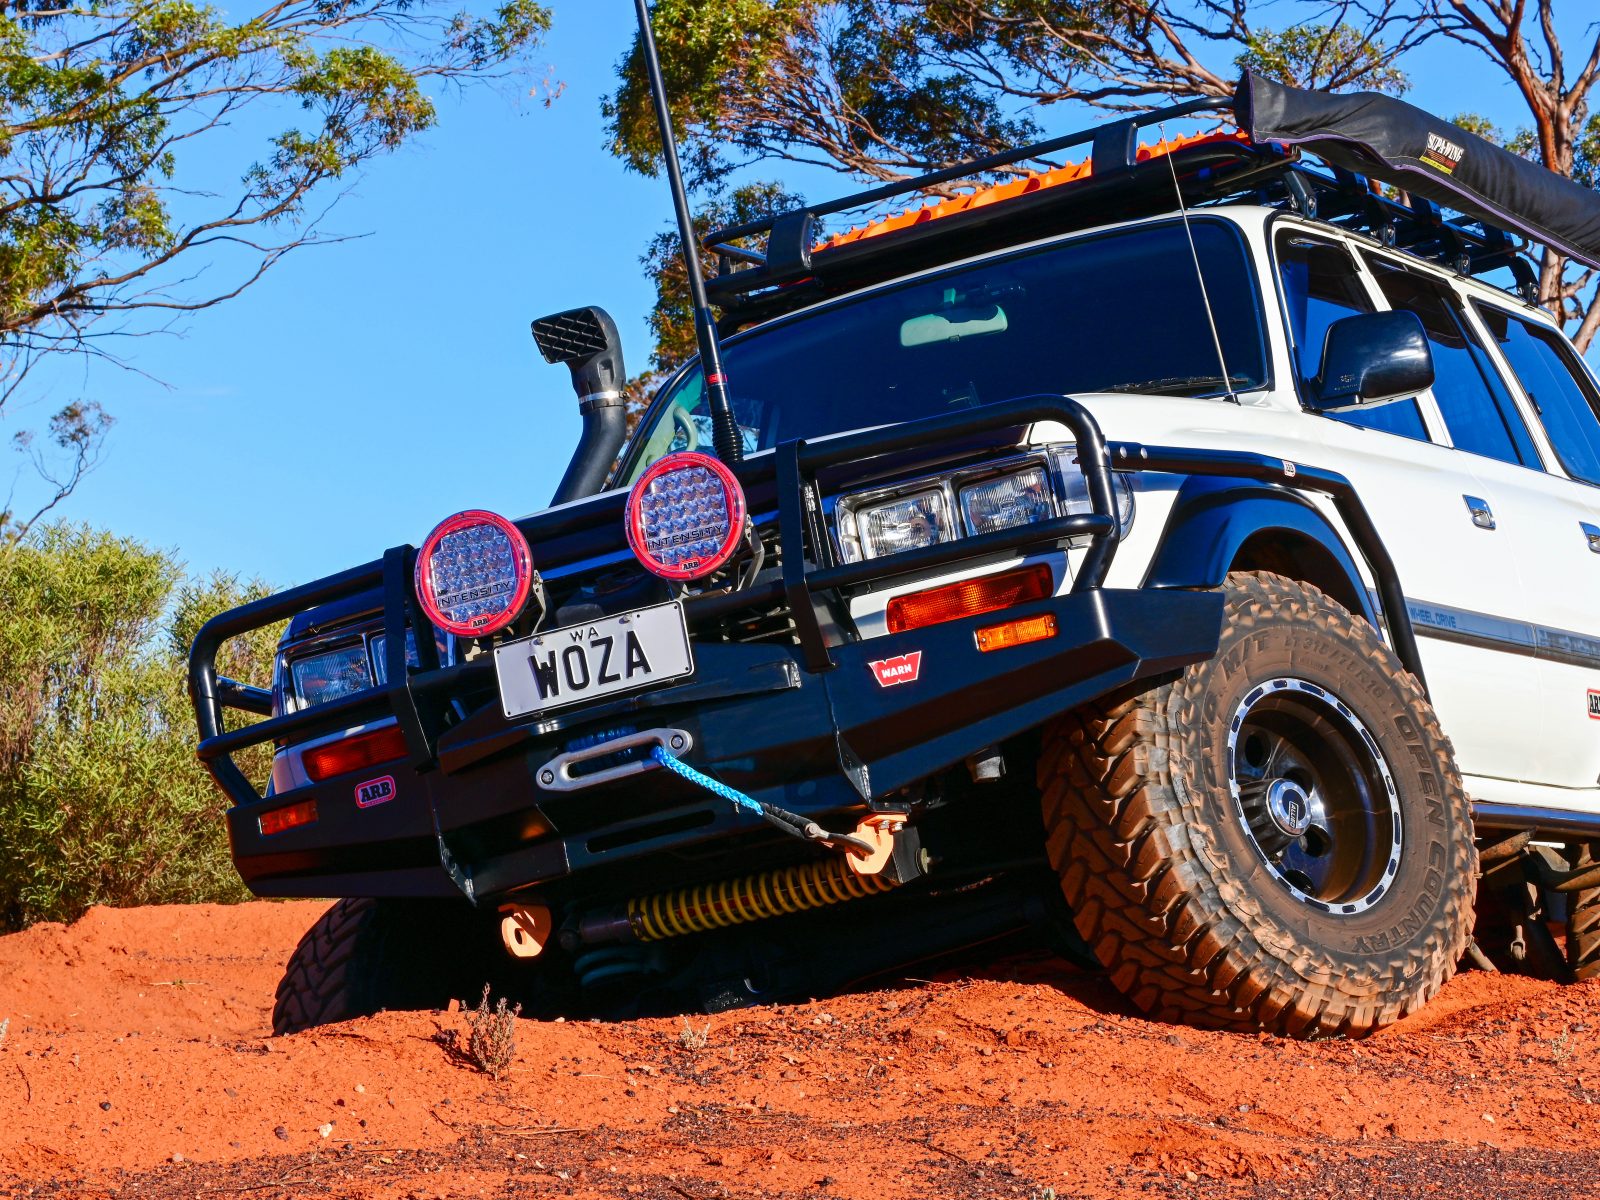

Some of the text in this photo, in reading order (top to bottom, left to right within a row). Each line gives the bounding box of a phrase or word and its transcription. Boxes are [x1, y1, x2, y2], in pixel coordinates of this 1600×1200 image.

[647, 525, 723, 549] INTENSITY
[683, 561, 699, 571] ARB
[438, 580, 511, 605] INTENSITY
[472, 617, 489, 627] ARB
[1409, 607, 1457, 628] WHEEL DRIVE
[570, 627, 599, 642] WA
[528, 630, 652, 700] WOZA
[881, 663, 912, 678] WARN
[360, 781, 392, 803] ARB
[1351, 715, 1445, 954] OPEN COUNTRY
